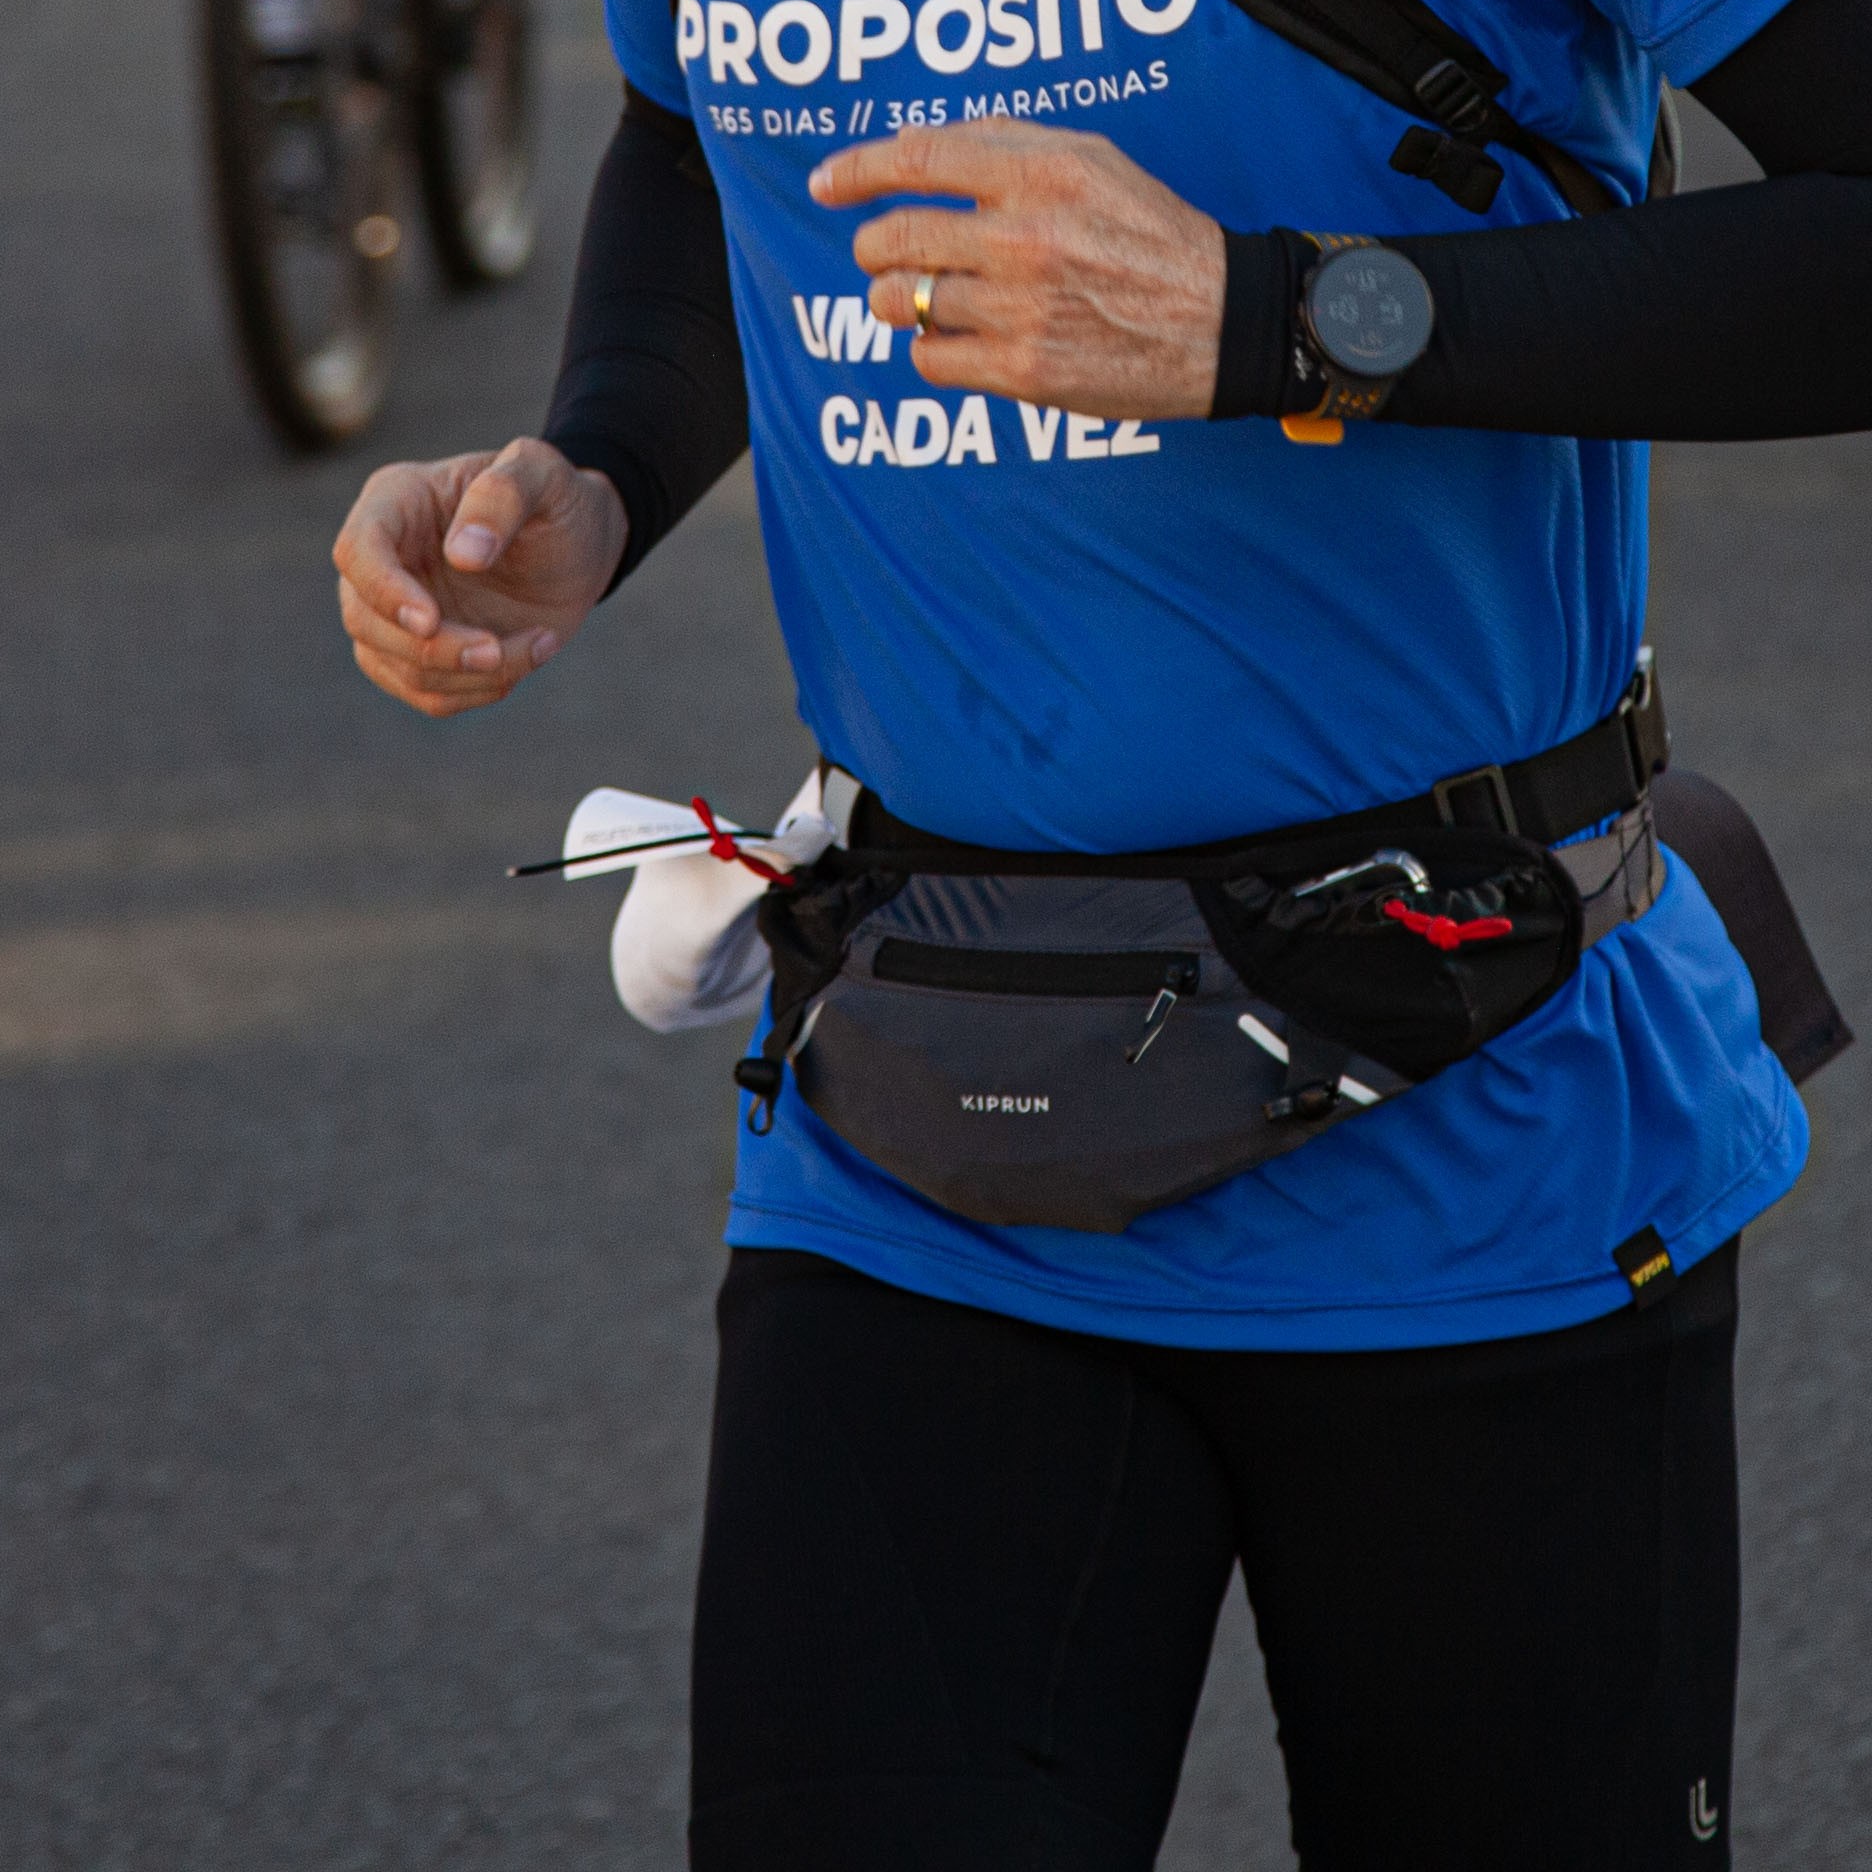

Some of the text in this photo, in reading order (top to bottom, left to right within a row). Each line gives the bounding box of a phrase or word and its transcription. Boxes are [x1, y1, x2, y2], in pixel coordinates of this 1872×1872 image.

[763, 106, 835, 136] DIAS
[886, 98, 949, 129] 365
[963, 60, 1170, 122] MARATONAS
[791, 295, 894, 363] UM
[820, 394, 997, 467] CADA
[960, 1094, 1050, 1113] KIPRUN
